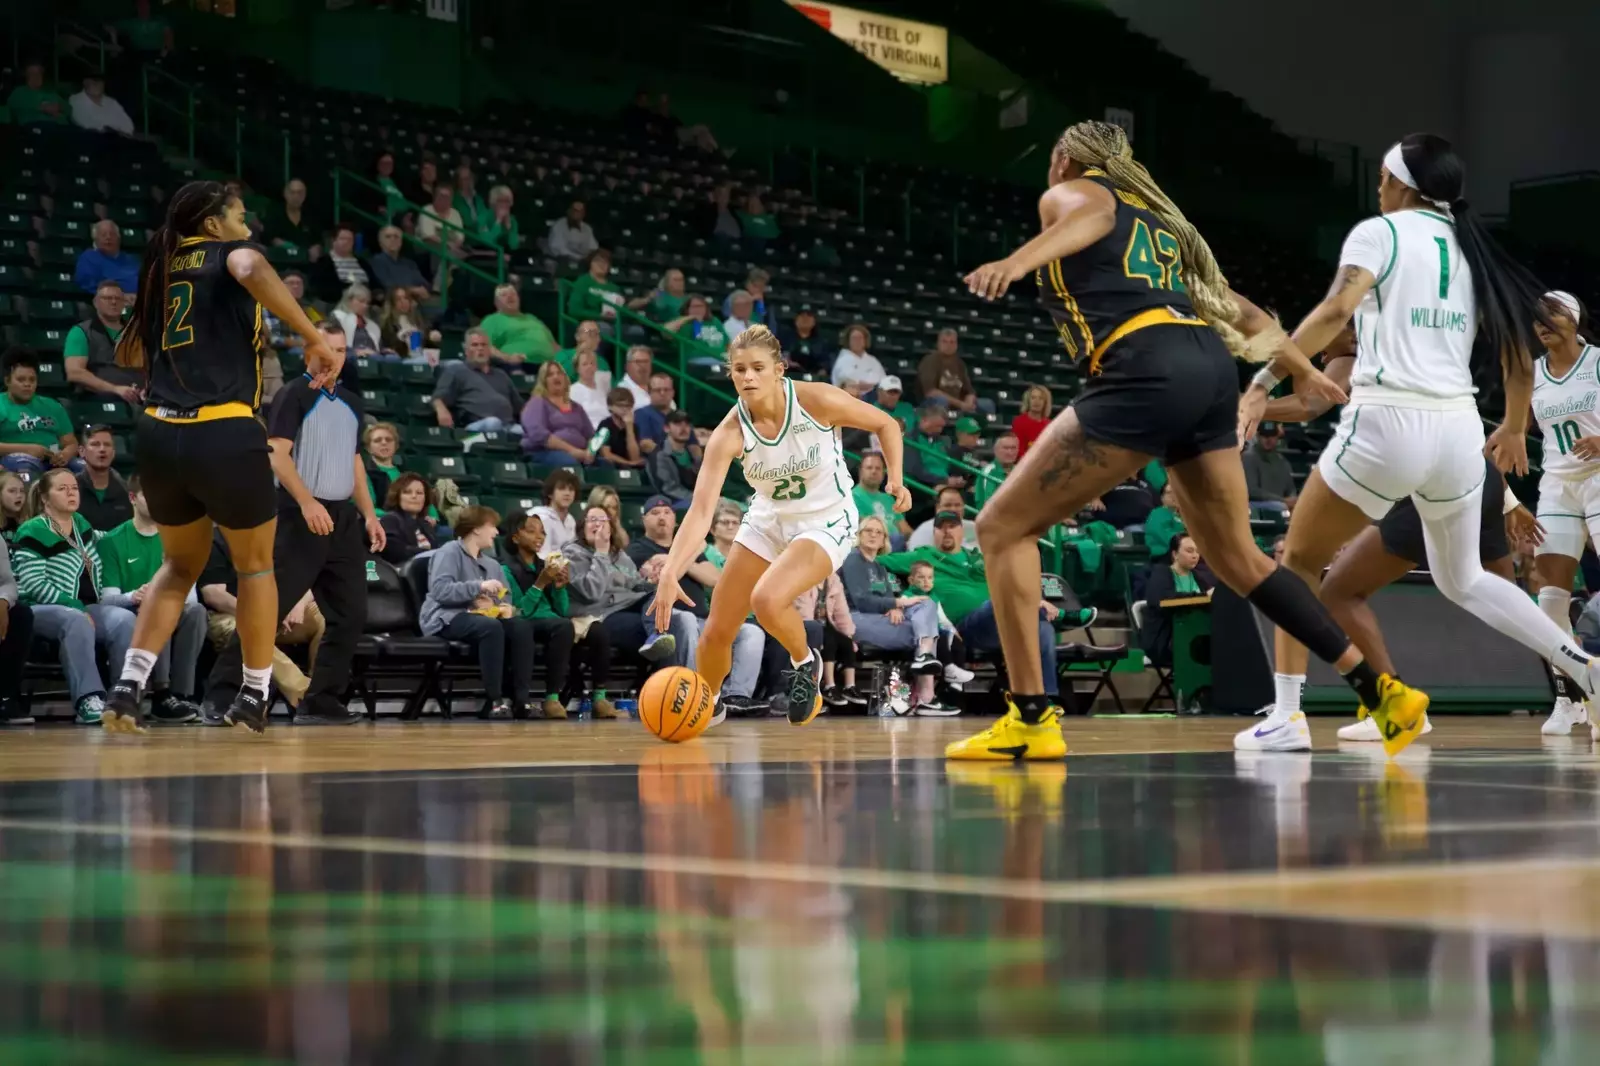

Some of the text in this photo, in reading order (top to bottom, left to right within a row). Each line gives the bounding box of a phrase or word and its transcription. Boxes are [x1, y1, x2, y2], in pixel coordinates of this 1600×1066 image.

[859, 21, 921, 47] STEEL OF
[881, 44, 942, 70] VIRGINIA
[1123, 217, 1188, 292] 42
[1433, 236, 1450, 300] 1
[162, 281, 194, 351] 2
[1411, 307, 1468, 333] WILLIAMS
[1551, 420, 1583, 456] 10
[747, 442, 822, 481] Marshall
[771, 475, 808, 501] 23
[670, 677, 692, 714] NCAA
[687, 683, 710, 729] Wilson
